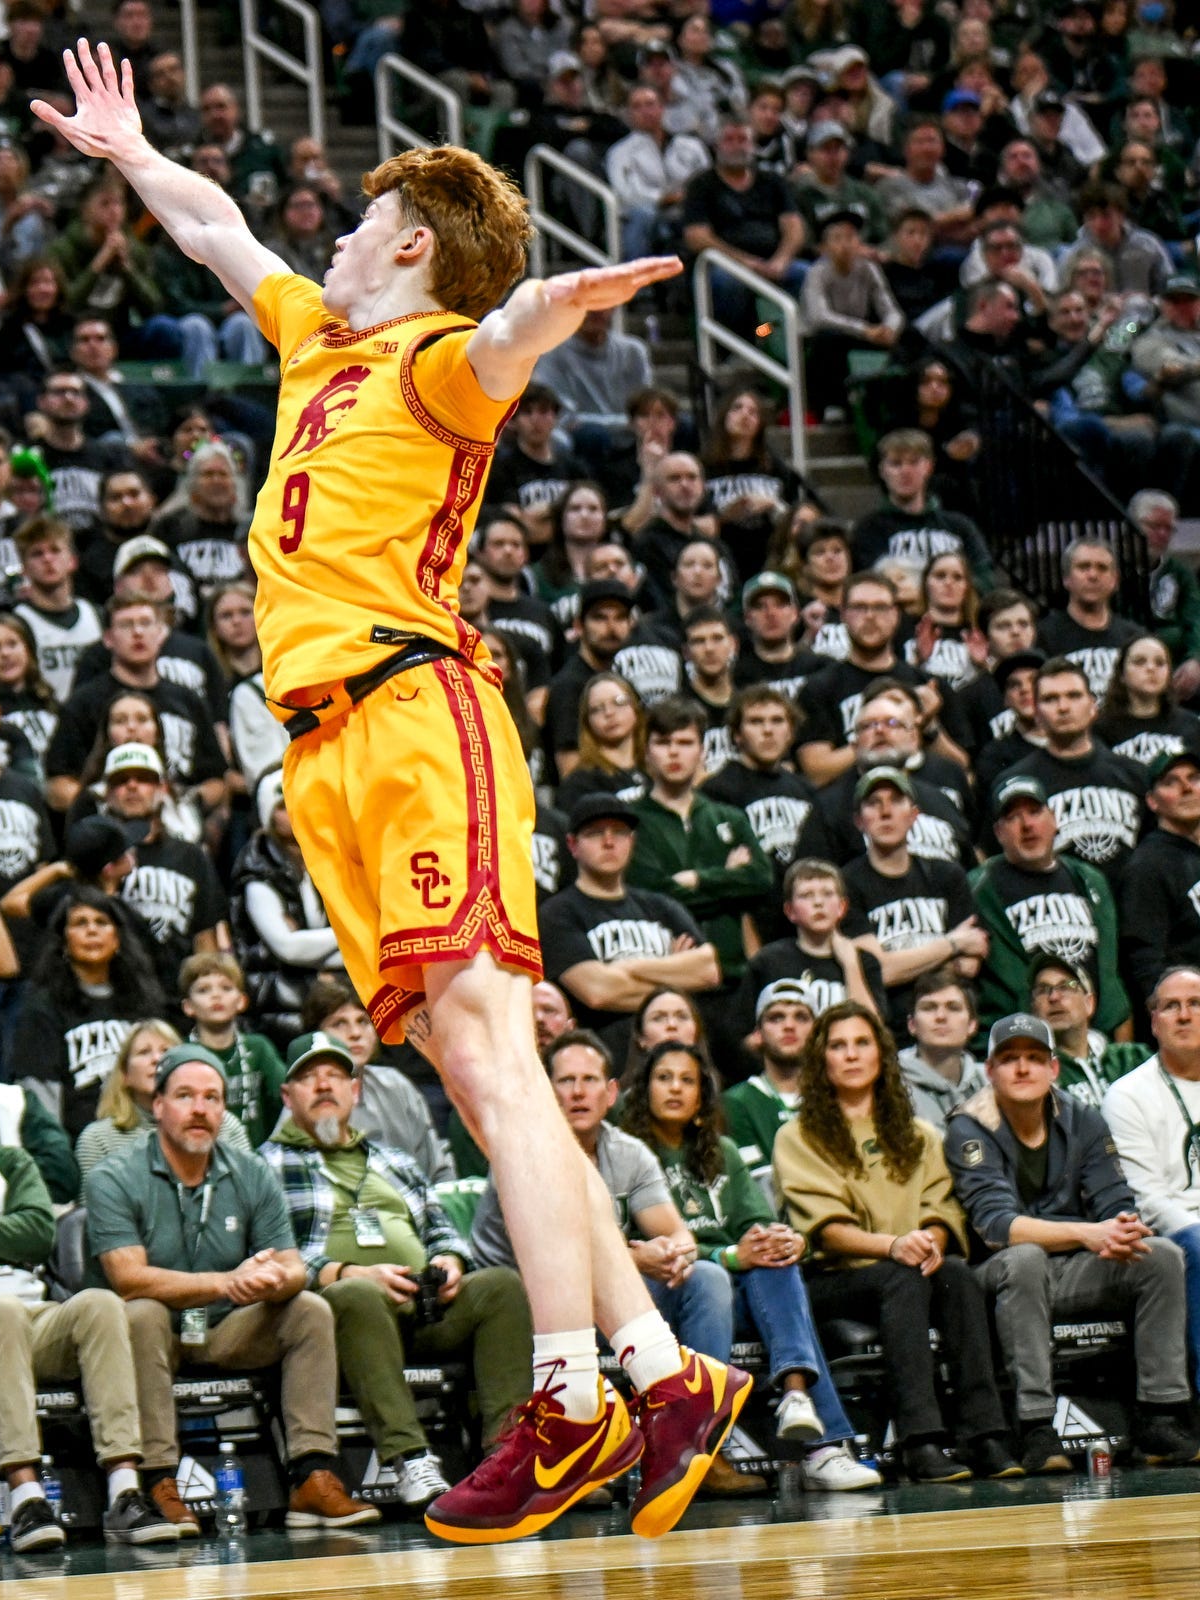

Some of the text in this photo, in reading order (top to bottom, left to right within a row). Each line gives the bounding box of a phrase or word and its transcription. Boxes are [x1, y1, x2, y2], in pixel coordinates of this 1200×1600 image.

[279, 471, 312, 555] 9
[1047, 785, 1141, 834] ZZONE
[125, 866, 196, 914] ZONE
[410, 851, 452, 909] SC
[1005, 893, 1092, 936] IZZON
[64, 1020, 130, 1073] IZZO
[403, 1368, 443, 1383] TANS
